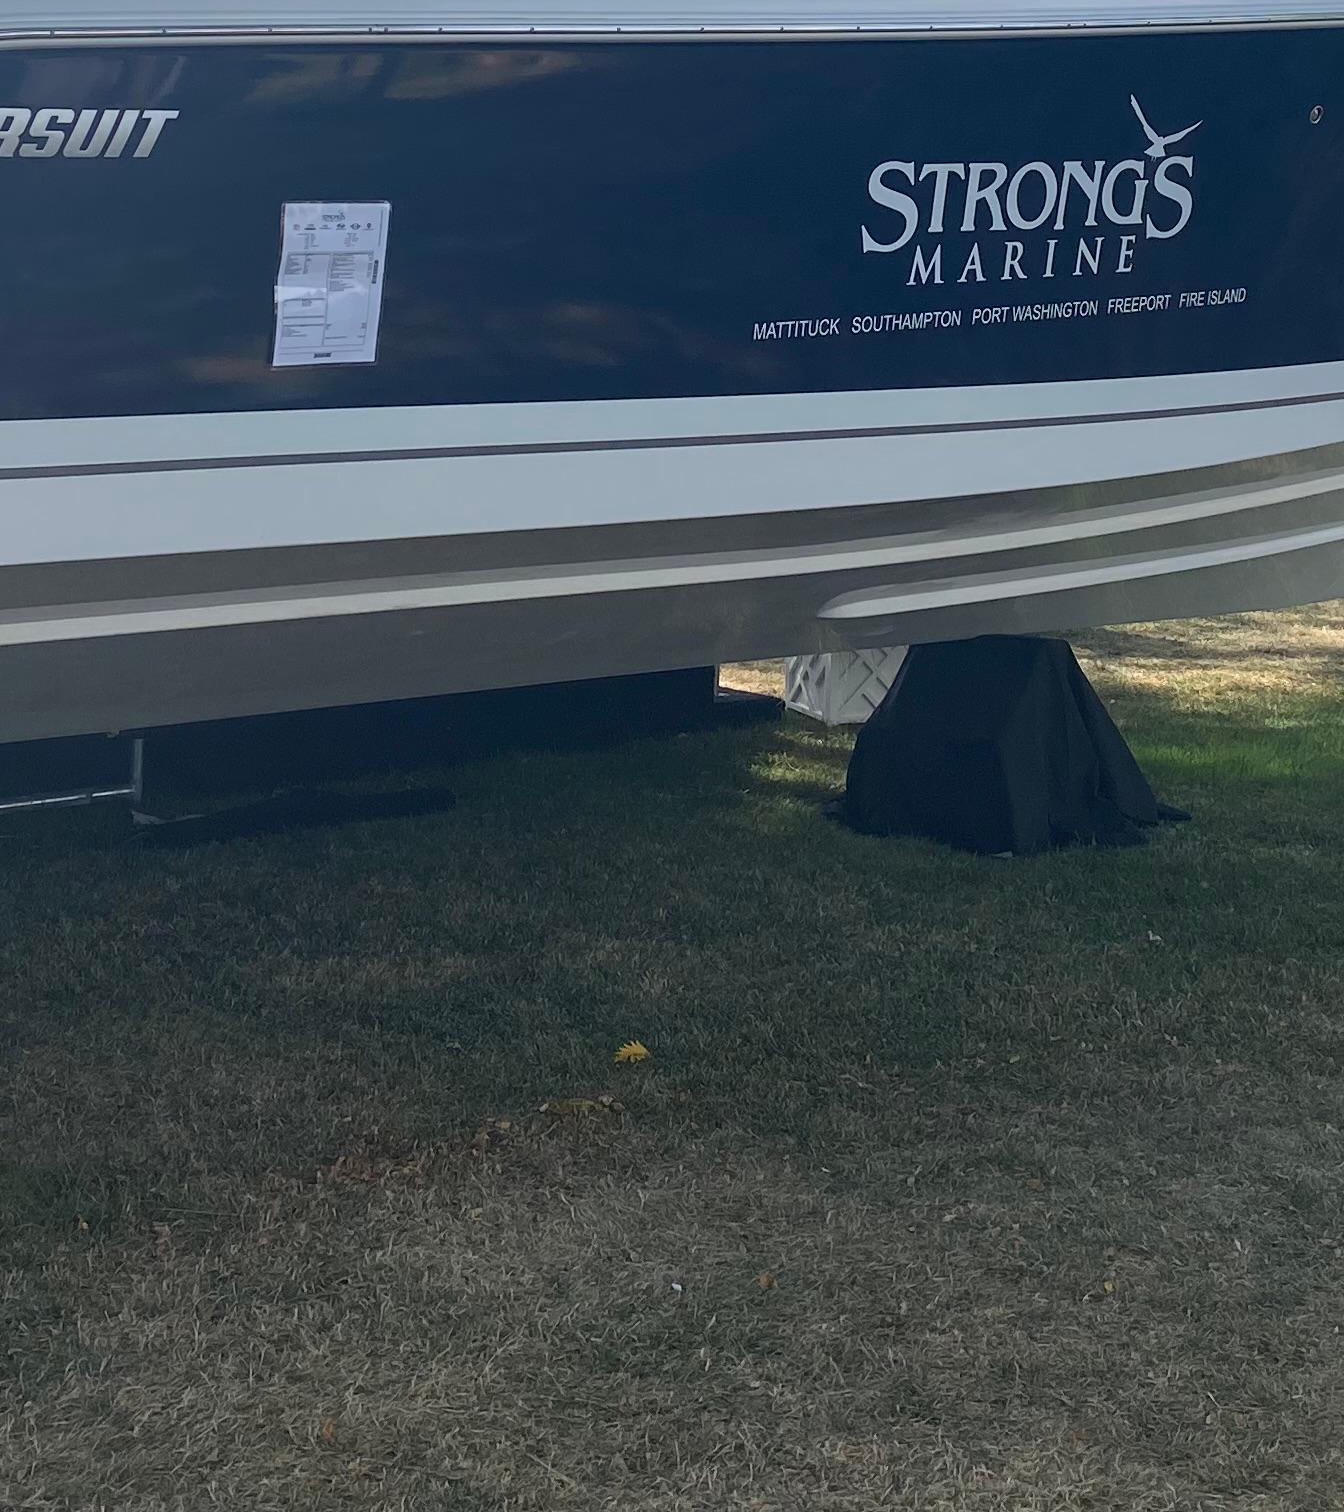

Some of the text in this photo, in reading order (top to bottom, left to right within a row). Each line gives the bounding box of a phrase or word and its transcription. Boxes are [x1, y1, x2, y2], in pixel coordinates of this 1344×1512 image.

[906, 235, 1136, 285] MARINE
[1107, 294, 1171, 315] FREEPORT
[1179, 287, 1247, 308] FIRE ISLAND
[851, 310, 962, 334] SOUTHAMPTON
[971, 300, 1099, 326] PORT WASHINGTON
[753, 318, 840, 340] MATTITUCK
